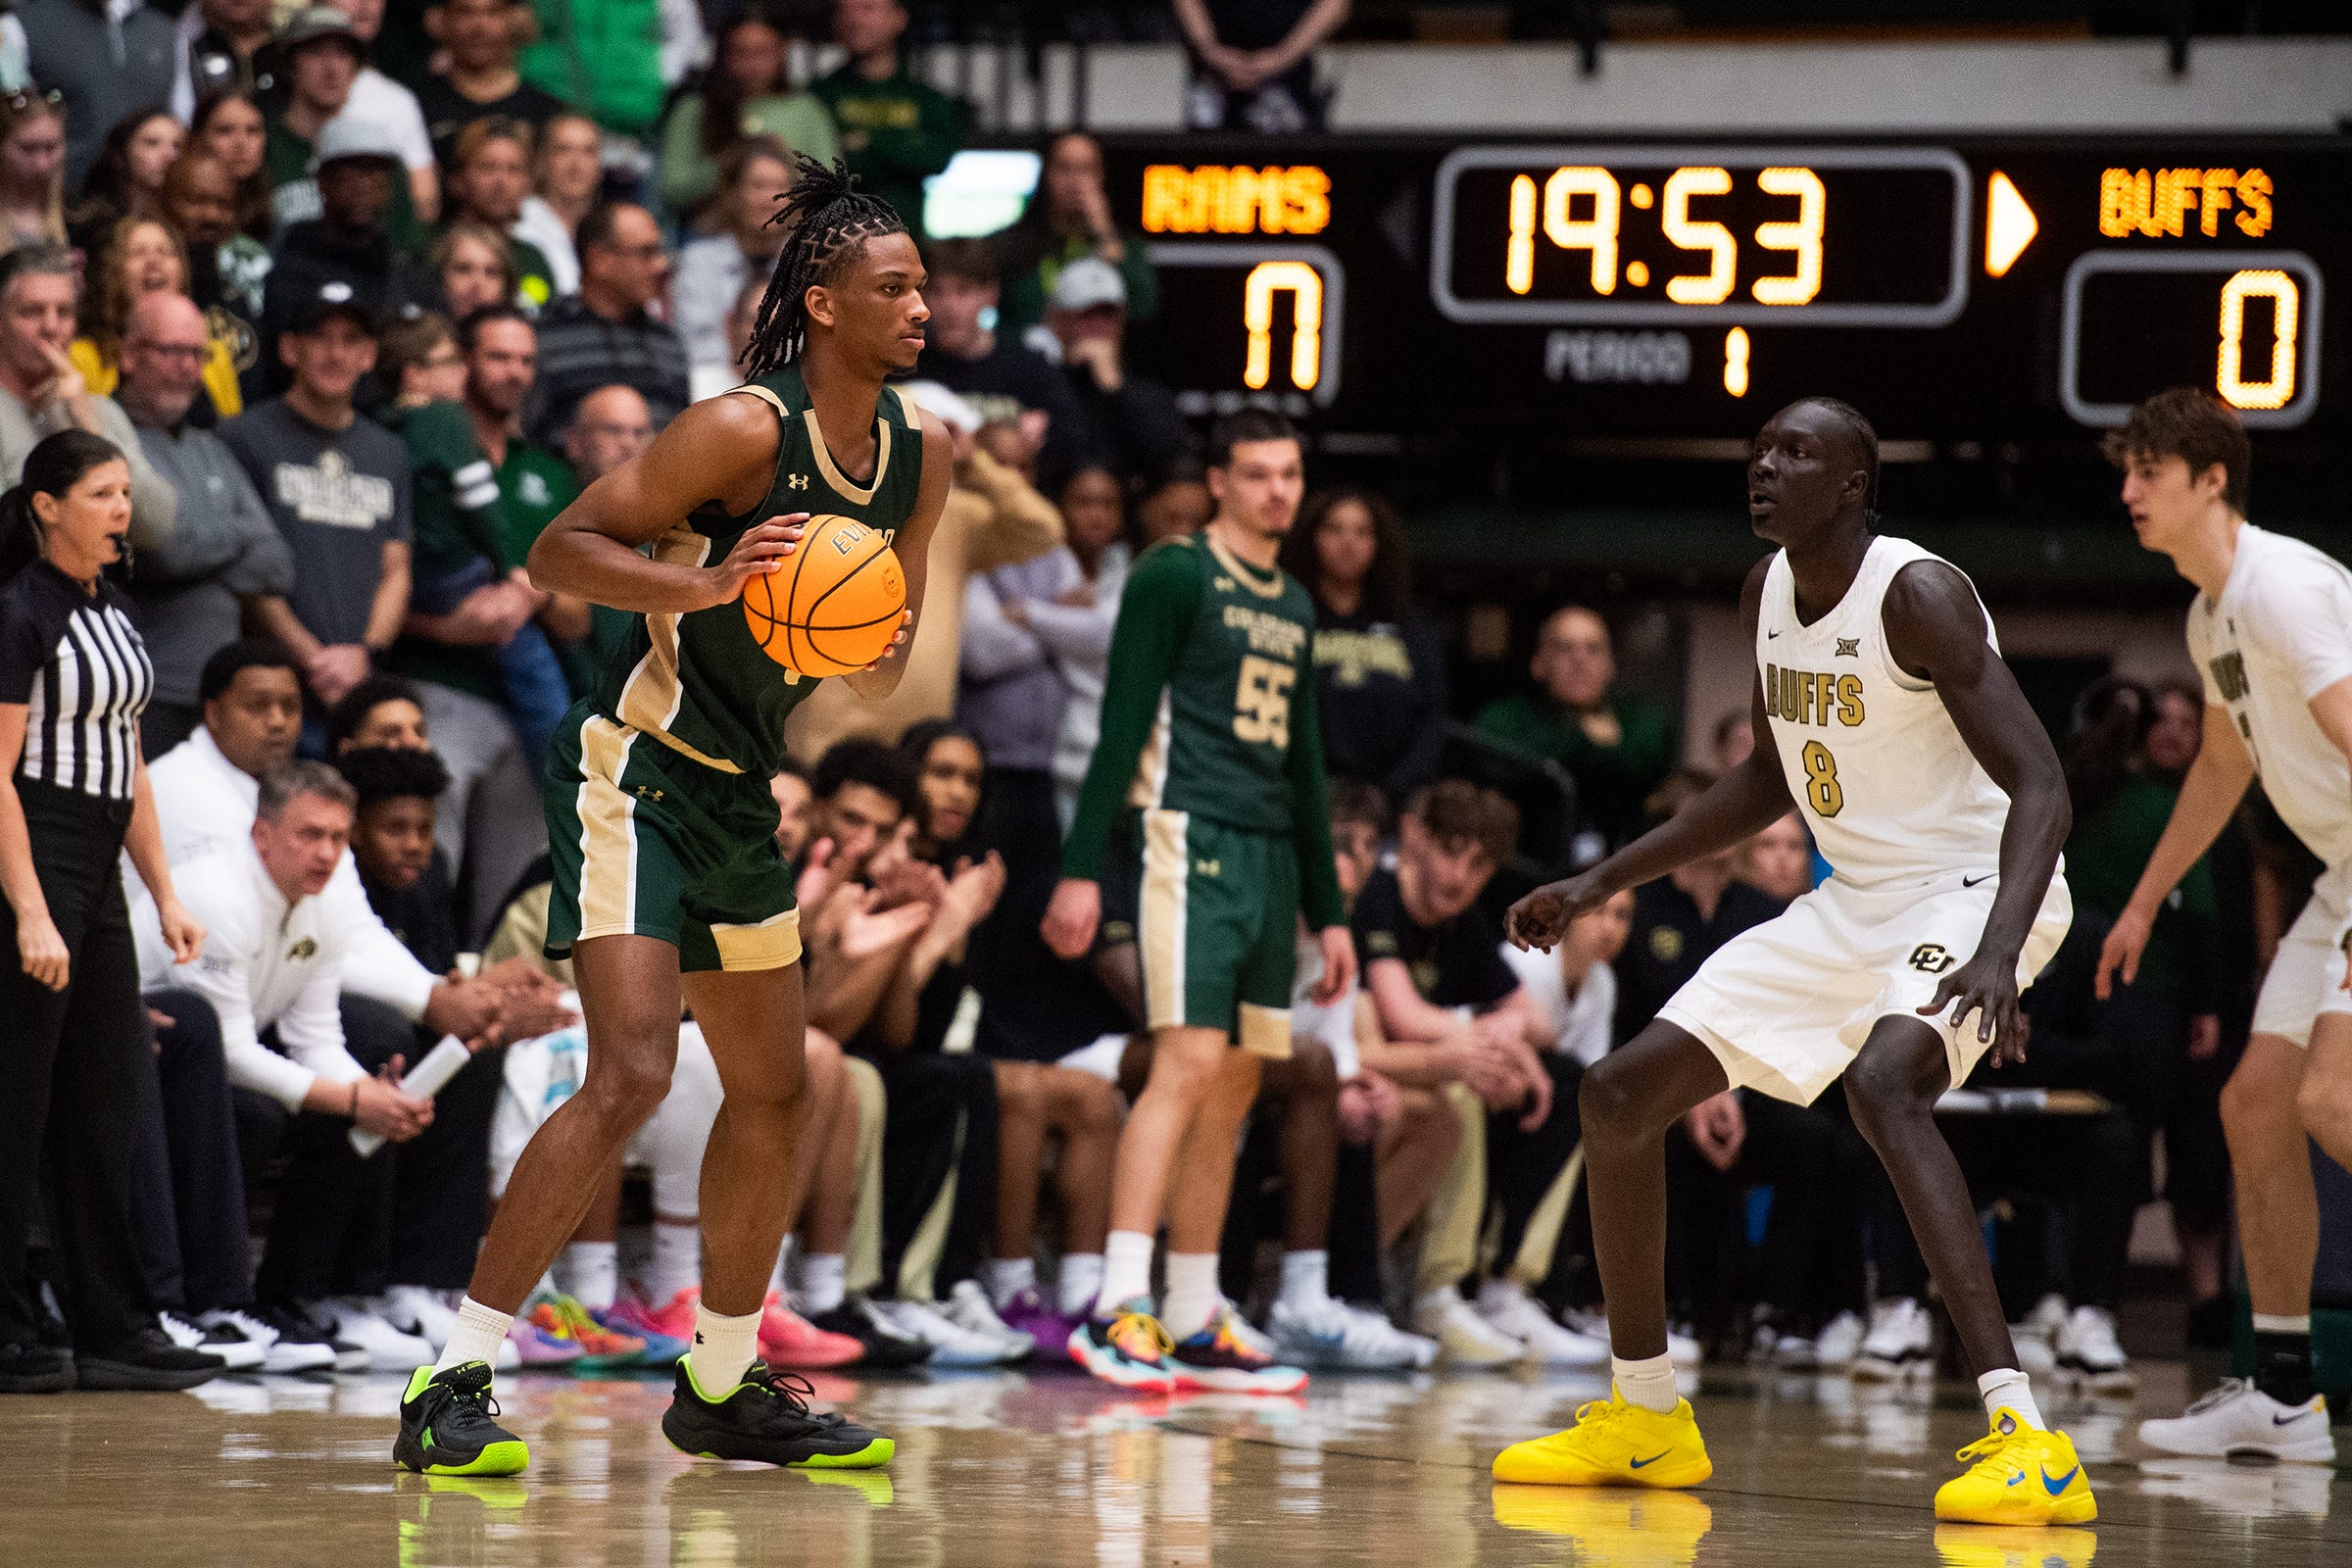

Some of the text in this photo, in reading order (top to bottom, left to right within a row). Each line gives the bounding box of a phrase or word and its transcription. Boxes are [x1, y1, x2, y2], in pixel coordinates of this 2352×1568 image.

[1143, 165, 1332, 234] RAMS
[2099, 168, 2274, 237] BUFFS
[1506, 166, 1826, 306] 19:53
[1724, 326, 1749, 397] 1
[2216, 270, 2298, 410] 0
[1767, 662, 1866, 727] BUFFS
[1801, 739, 1844, 818] 8
